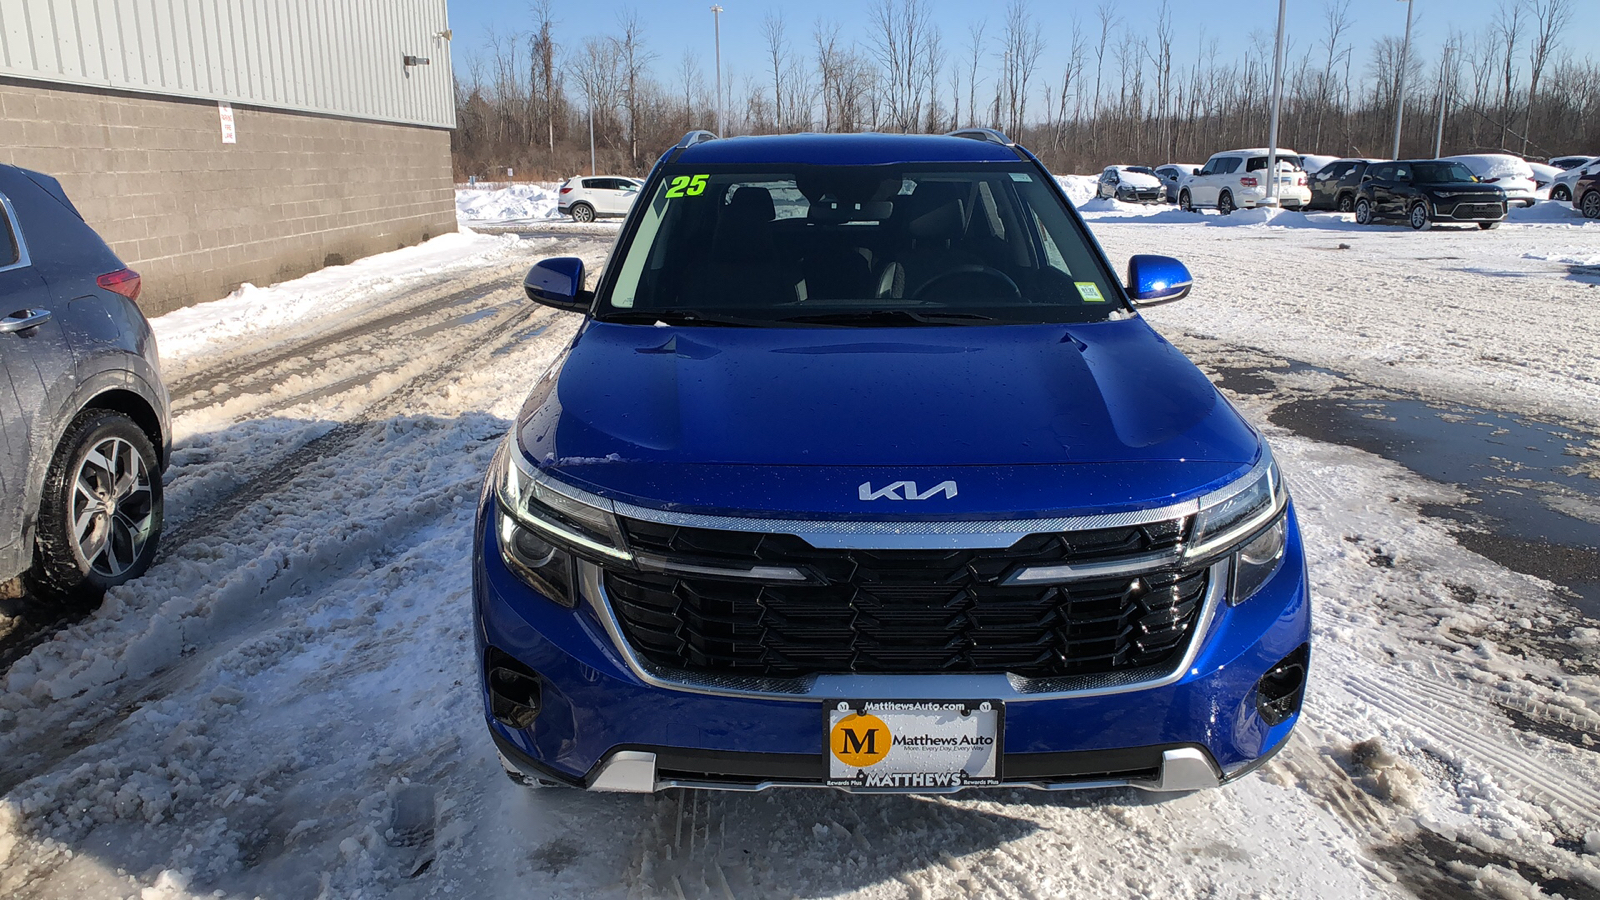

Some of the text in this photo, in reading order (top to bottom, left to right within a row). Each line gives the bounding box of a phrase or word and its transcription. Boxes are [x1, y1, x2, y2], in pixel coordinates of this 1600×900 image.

[665, 174, 710, 198] 25
[858, 481, 958, 500] KIA
[864, 701, 965, 711] MatthewsAuto.com
[839, 728, 879, 755] M
[892, 734, 994, 746] Matthews Auto
[865, 772, 962, 787] MATTHEWS
